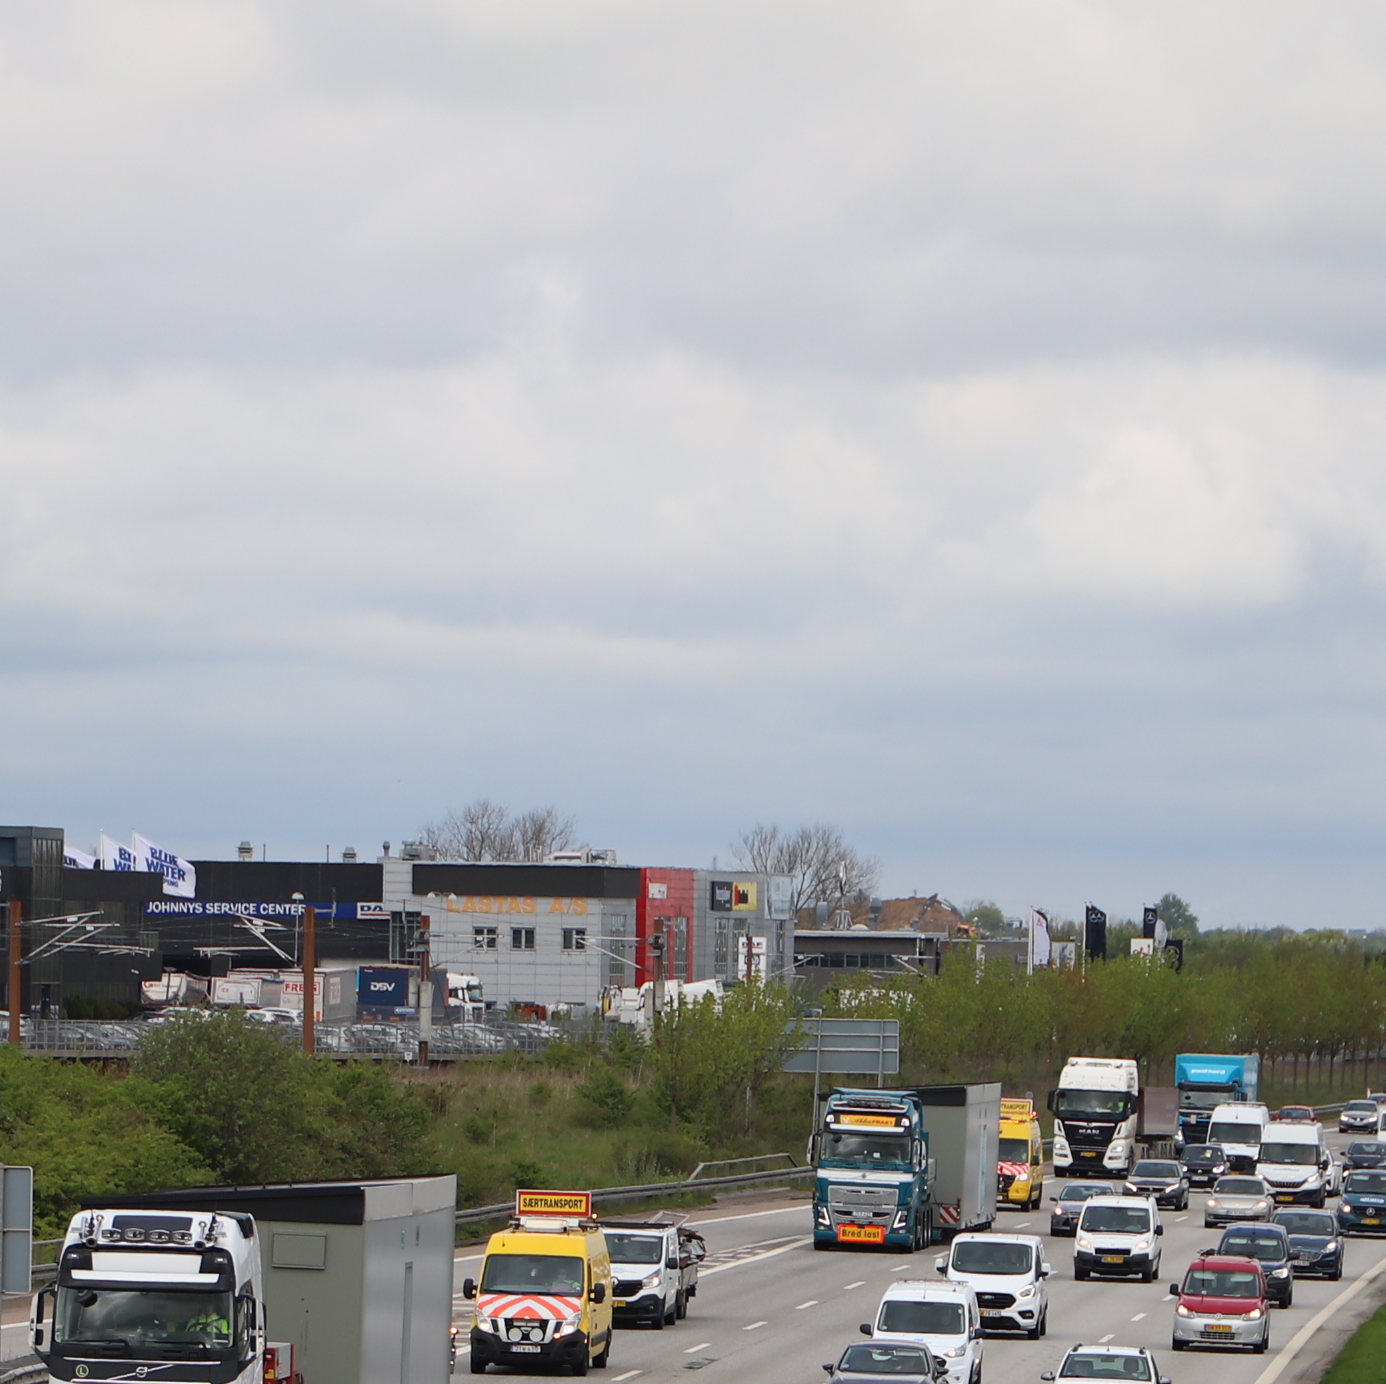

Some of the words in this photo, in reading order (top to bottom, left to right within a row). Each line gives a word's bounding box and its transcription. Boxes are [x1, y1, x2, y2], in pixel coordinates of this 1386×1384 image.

[149, 846, 179, 866] BLUE
[144, 857, 187, 882] WATER
[147, 902, 203, 913] JOHNNYS
[206, 903, 257, 915] SERVICE
[260, 904, 306, 916] CENTER
[447, 896, 537, 914] LASTAS
[548, 897, 588, 915] A/S
[370, 981, 395, 991] DSV
[522, 1197, 584, 1210] SÆRTRANSPORT
[841, 1229, 862, 1238] Bred
[864, 1230, 880, 1239] last
